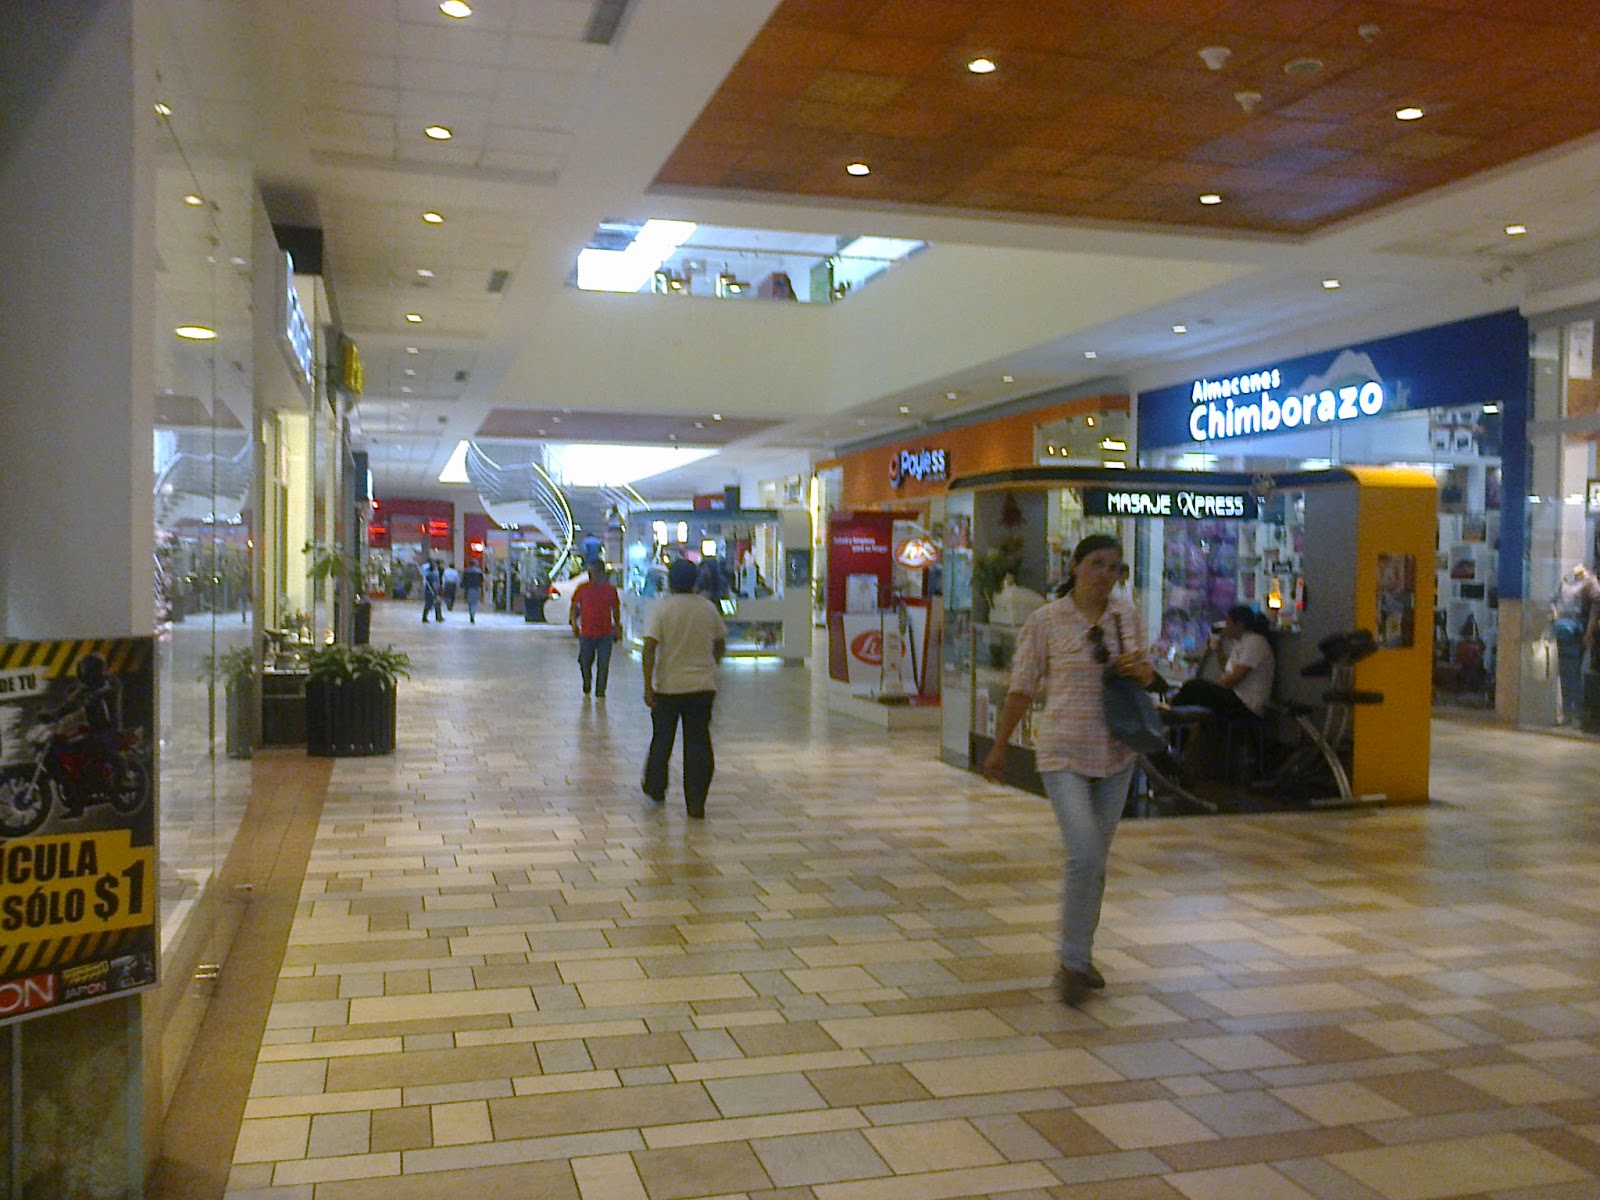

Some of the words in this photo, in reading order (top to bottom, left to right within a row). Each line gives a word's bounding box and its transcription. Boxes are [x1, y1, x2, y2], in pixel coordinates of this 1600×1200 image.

[1192, 368, 1281, 404] Almacenes
[1189, 380, 1385, 442] Chimborazo
[1107, 492, 1172, 515] MASAJE
[18, 672, 36, 691] TU
[2, 886, 86, 932] SÓLO
[94, 859, 145, 921] $1
